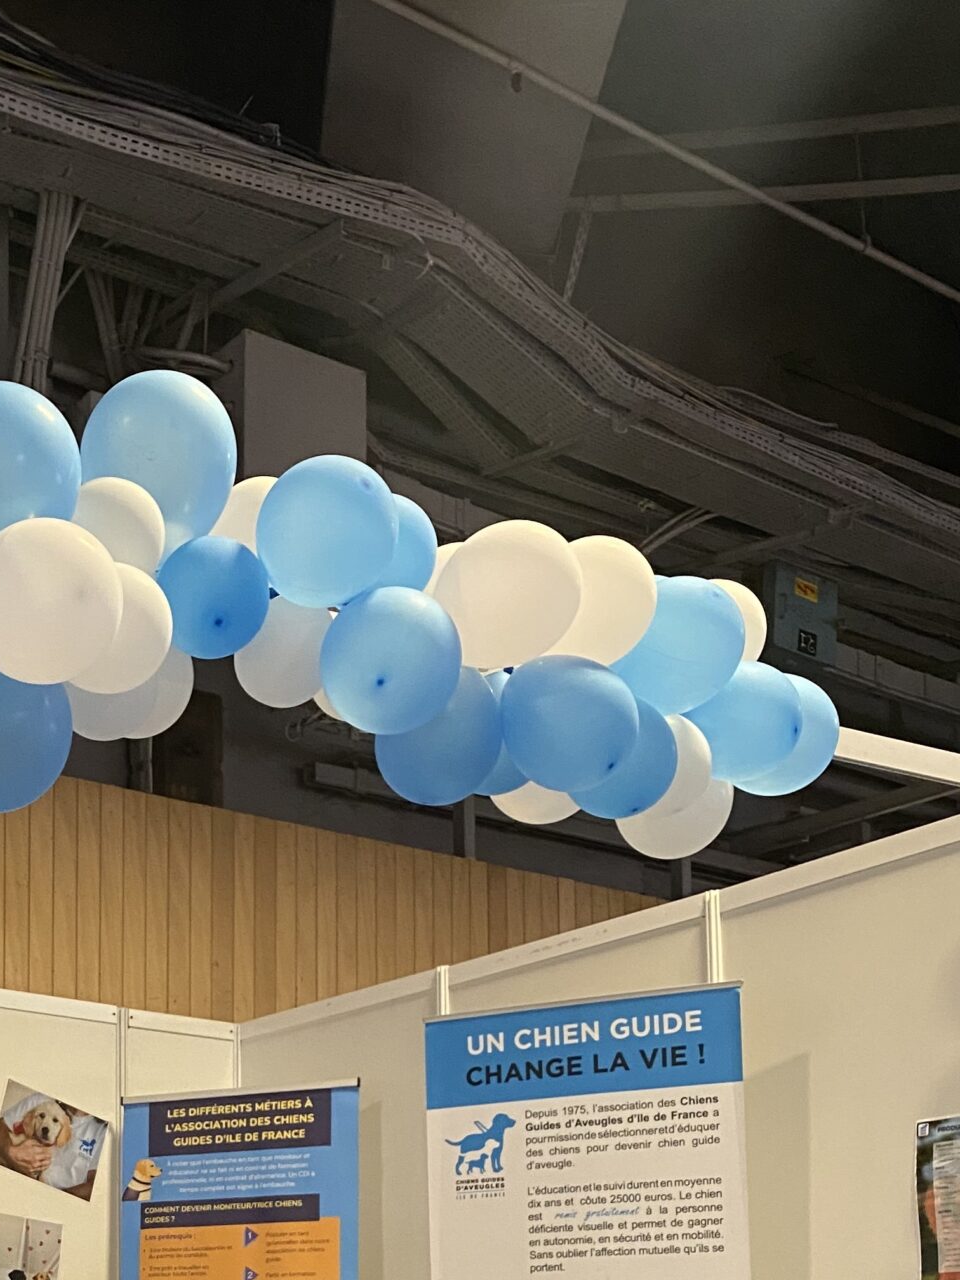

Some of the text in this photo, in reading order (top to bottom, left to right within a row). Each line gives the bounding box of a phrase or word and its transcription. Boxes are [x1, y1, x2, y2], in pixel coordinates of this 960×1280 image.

[467, 1010, 702, 1055] UN CHIEN GUIDE
[466, 1043, 705, 1086] CHANGE LA VIE !
[168, 1096, 313, 1118] LES DIFFÉRENTS MÉTIERS À
[525, 1096, 719, 1120] Depuis 1975, l'association des Chiens
[165, 1113, 315, 1132] L'ASSOCIATION DES CHIENS
[525, 1121, 561, 1131] Guides
[565, 1116, 623, 1128] d'Aveugles
[653, 1112, 667, 1121] de
[671, 1110, 709, 1120] France
[713, 1109, 720, 1117] a
[173, 1129, 306, 1146] GUIDES D'ILE DE FRANCE
[525, 1135, 720, 1158] des chiens pour devenir chien guide
[526, 1159, 575, 1170] d'aveugle.
[527, 1185, 581, 1196] L'éducation
[583, 1184, 592, 1192] et
[603, 1181, 626, 1191] suivi
[627, 1180, 659, 1189] durent
[674, 1177, 722, 1188] moyenne
[144, 1206, 180, 1214] COMMENT
[181, 1204, 212, 1213] DEVENIR
[274, 1199, 303, 1207] CHIENS
[527, 1199, 541, 1208] dix
[564, 1198, 574, 1206] et
[610, 1193, 641, 1204] 25000
[644, 1193, 676, 1201] euros.
[679, 1191, 692, 1200] Le
[695, 1189, 722, 1199] chien
[144, 1216, 170, 1224] GUIDES
[528, 1213, 542, 1221] est
[646, 1206, 652, 1215] à
[660, 1205, 668, 1214] la
[675, 1204, 723, 1215] personne
[528, 1218, 724, 1234] déficiente visuelle et permet de gagner
[529, 1239, 540, 1247] en
[543, 1235, 596, 1246] autonomie,
[613, 1232, 651, 1243] sécurité
[654, 1232, 664, 1240] et
[529, 1244, 724, 1260] Sans oublier l'affection mutuelle qu'ils se
